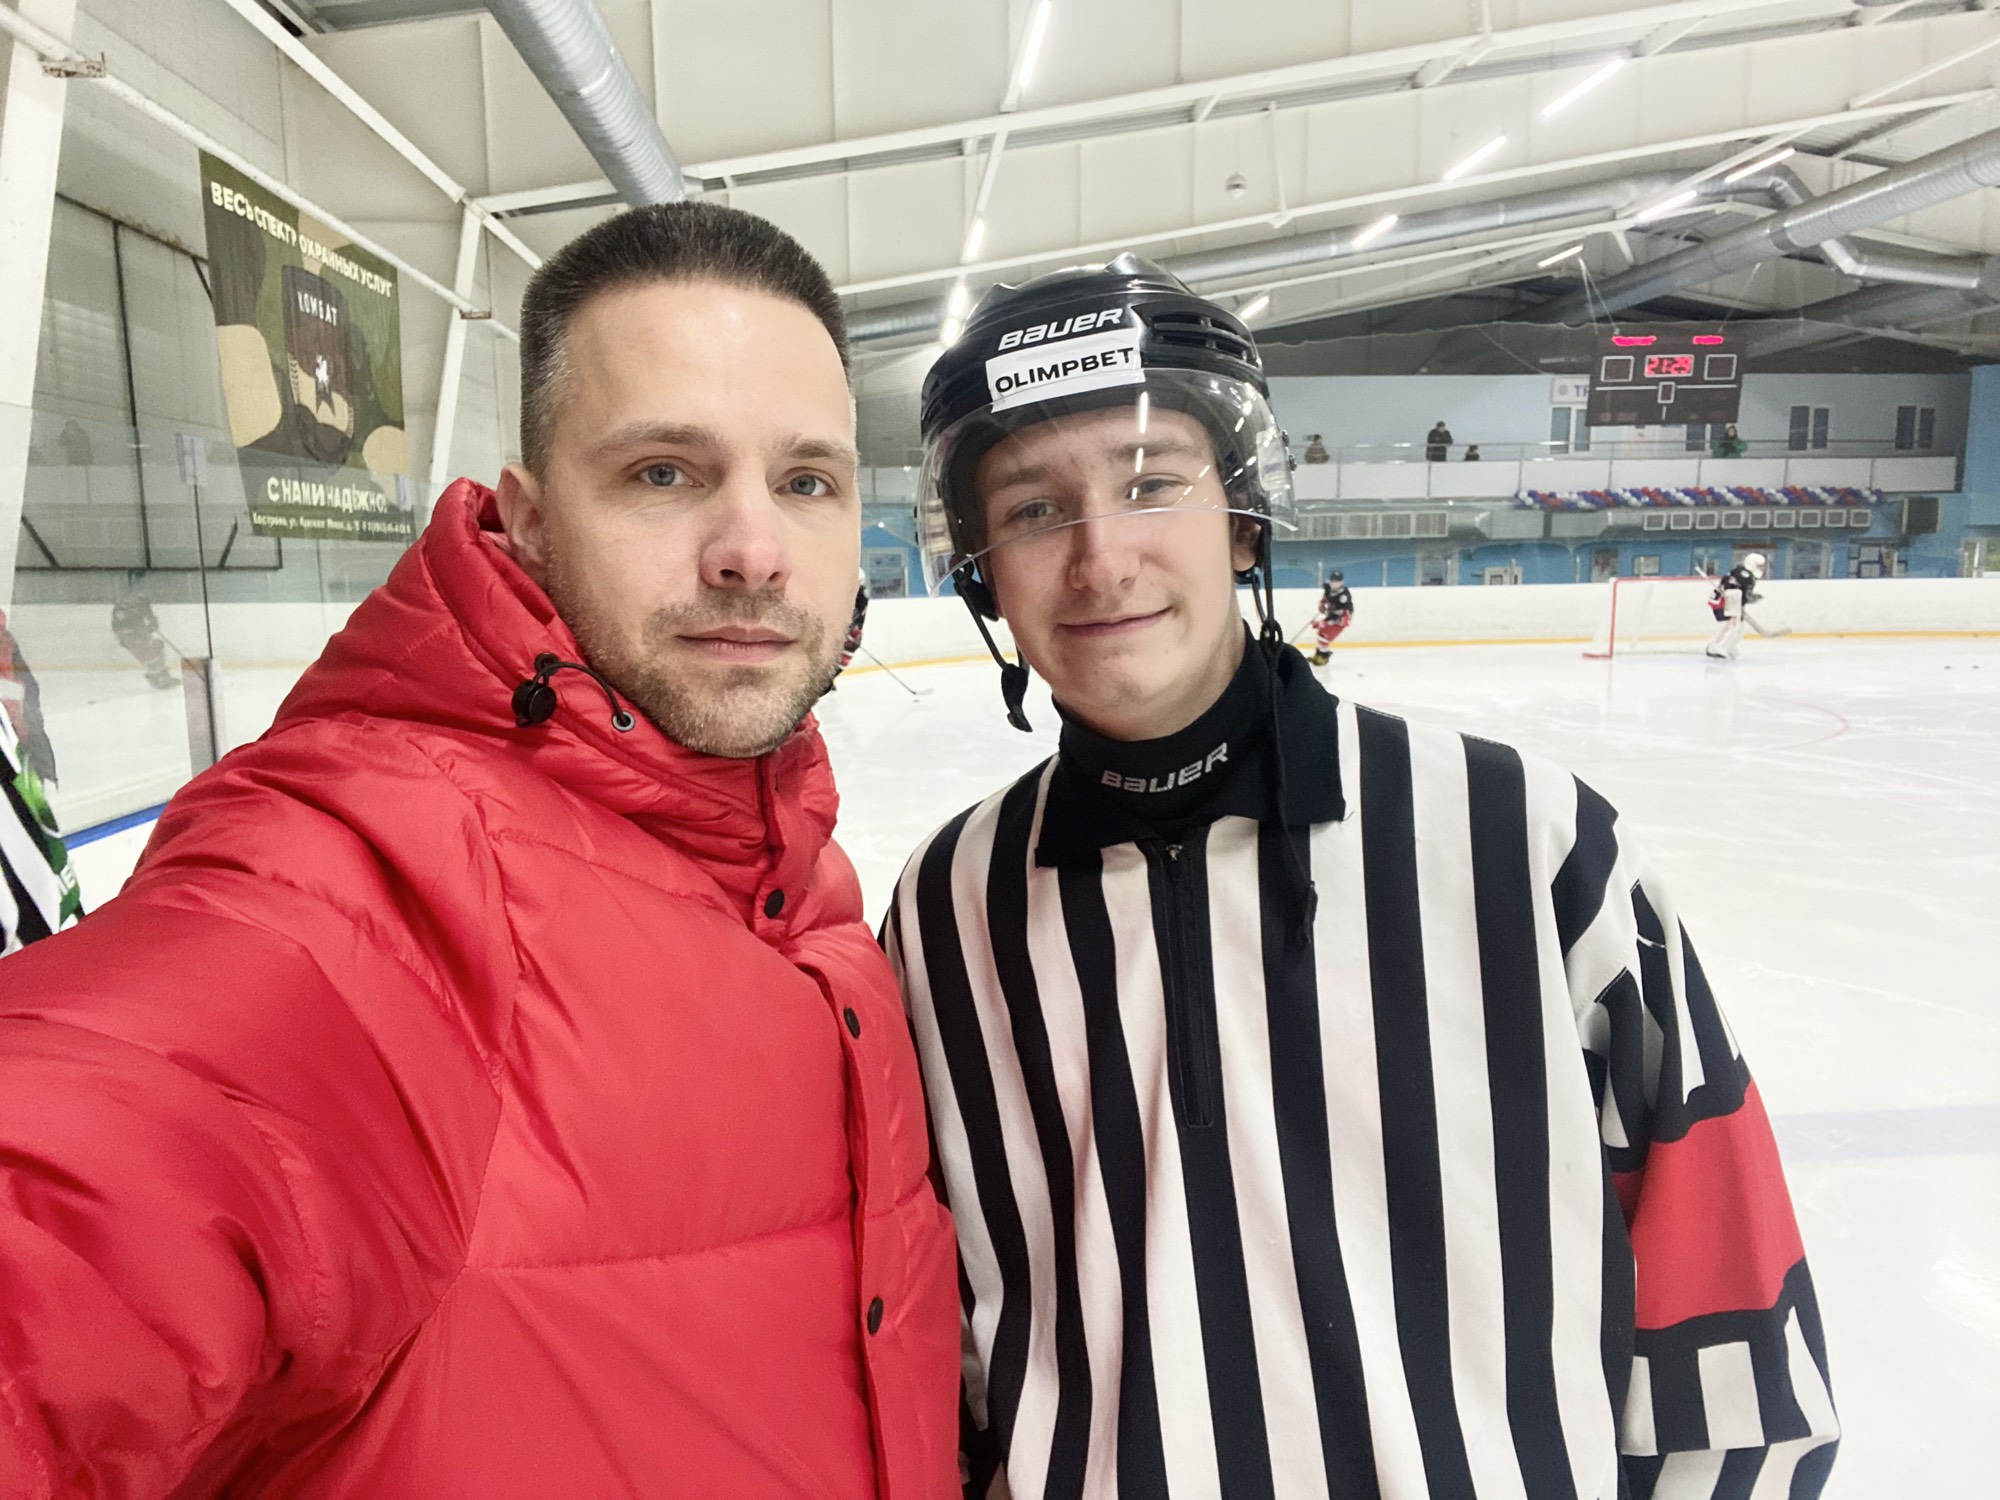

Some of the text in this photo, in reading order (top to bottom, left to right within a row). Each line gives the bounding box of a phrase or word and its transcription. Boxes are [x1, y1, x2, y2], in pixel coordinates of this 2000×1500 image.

[210, 180, 254, 222] ВЕСЬ
[998, 308, 1123, 351] BAUER
[995, 347, 1134, 393] OLIMPBET
[267, 476, 280, 502] С
[281, 478, 325, 507] НАМИ
[1101, 742, 1229, 793] BAUER
